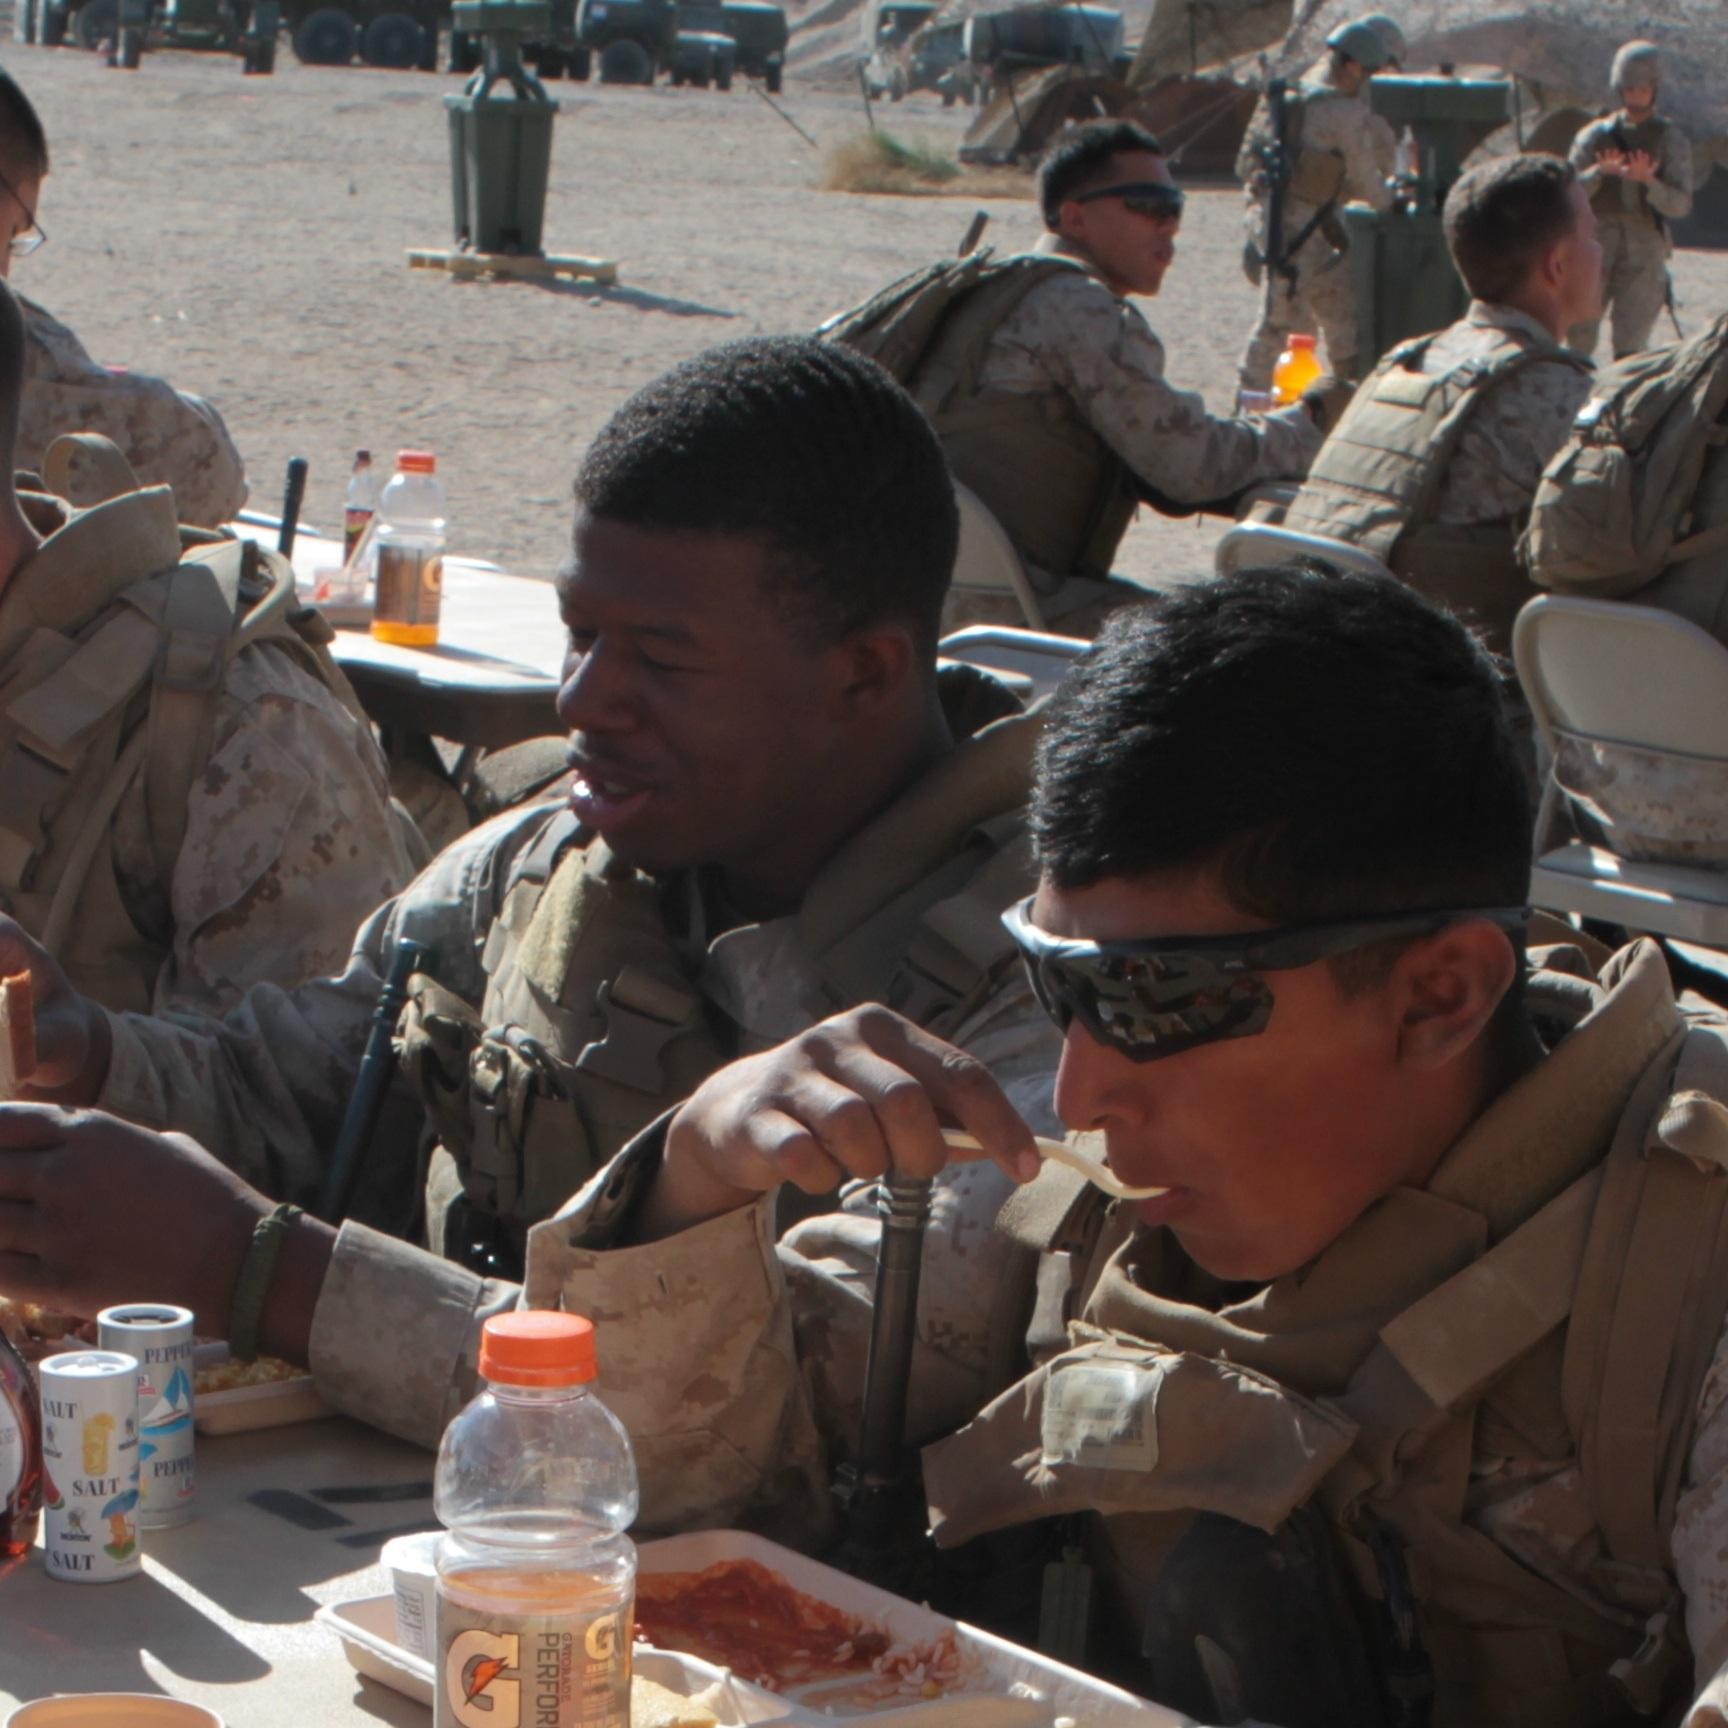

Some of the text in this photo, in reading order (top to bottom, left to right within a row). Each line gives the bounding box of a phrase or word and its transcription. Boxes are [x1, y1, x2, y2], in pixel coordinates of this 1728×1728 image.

[73, 1476, 120, 1497] SALT
[52, 1550, 96, 1571] SALT
[585, 1612, 618, 1661] G
[561, 1632, 572, 1702] GATORADE
